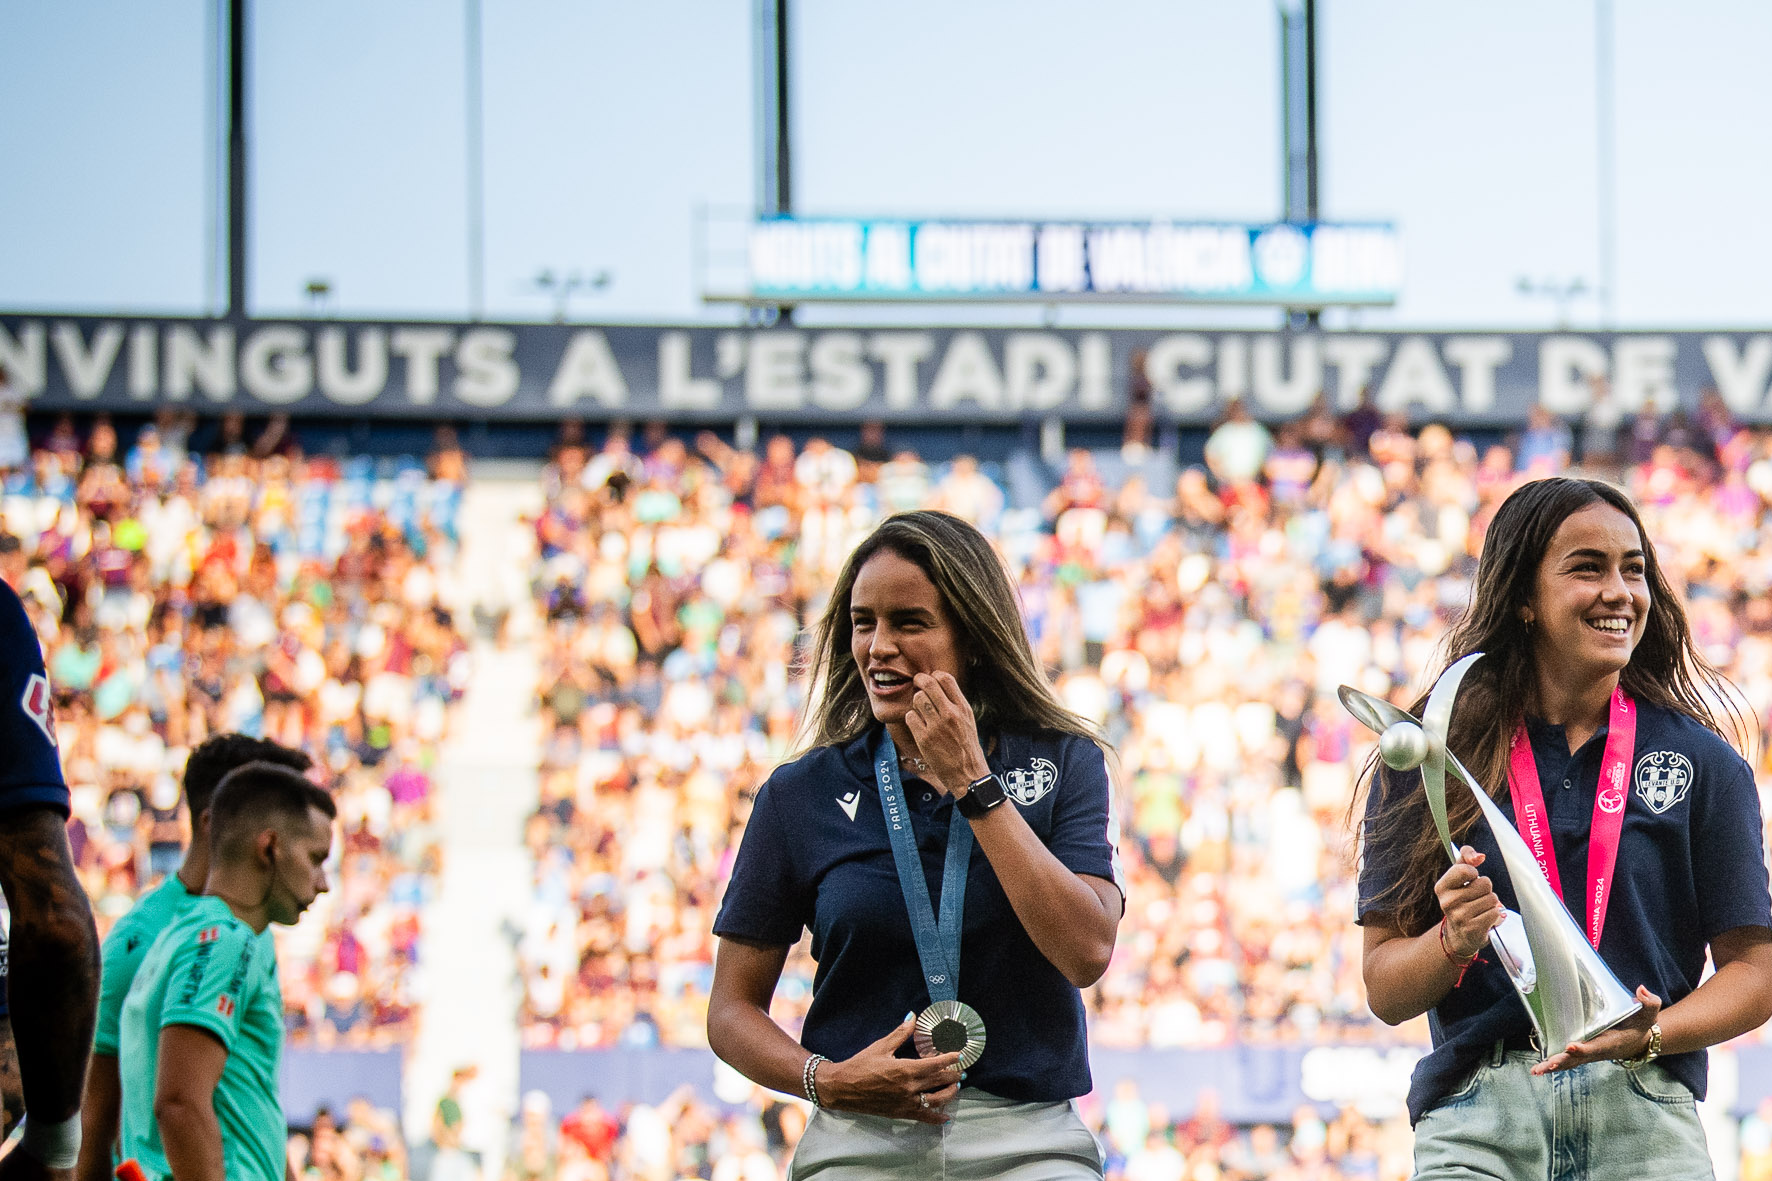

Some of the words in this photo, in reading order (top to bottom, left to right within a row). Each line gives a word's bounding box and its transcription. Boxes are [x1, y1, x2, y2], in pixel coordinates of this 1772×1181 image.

[549, 330, 629, 404] A
[659, 331, 1112, 410] L'ESTADI
[1146, 335, 1513, 414] CIUTAT
[1537, 336, 1679, 416] DE
[880, 760, 893, 792] 2024
[886, 795, 903, 831] PARIS
[1525, 803, 1545, 858] LITHUANIA
[1594, 877, 1605, 904] 2024
[1592, 906, 1601, 947] HUANIA
